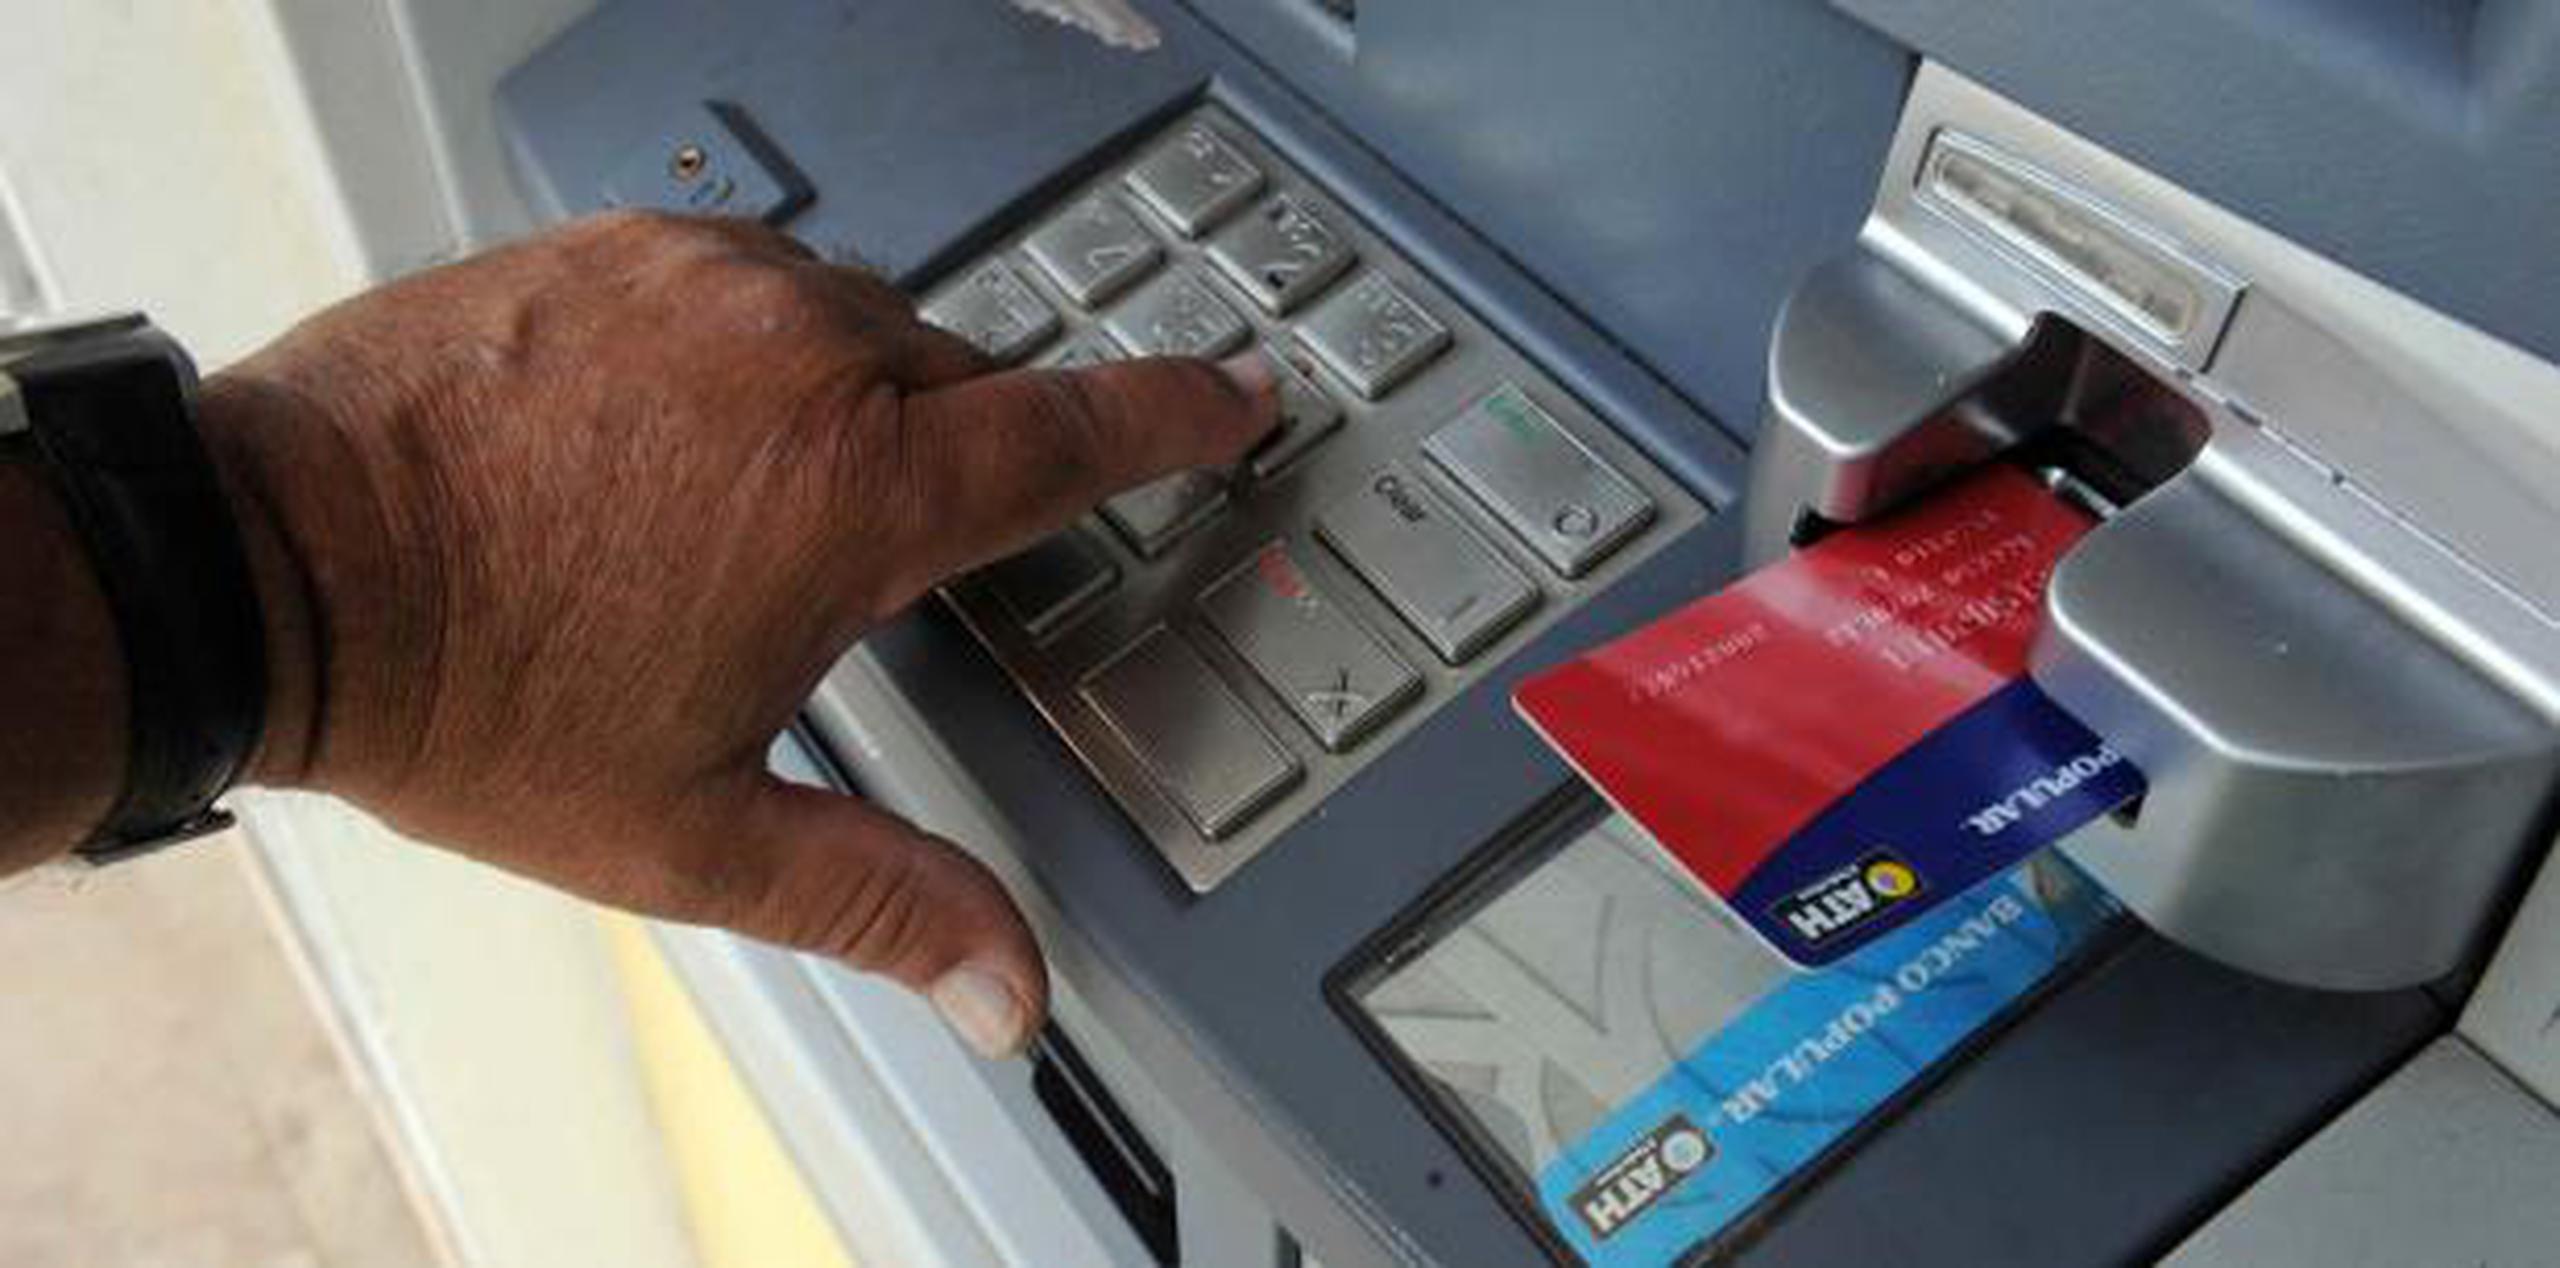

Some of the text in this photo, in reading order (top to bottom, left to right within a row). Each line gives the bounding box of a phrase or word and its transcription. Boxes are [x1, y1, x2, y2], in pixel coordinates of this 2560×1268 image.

[1974, 743, 2121, 837] POPULAR
[1789, 872, 1882, 940] ATH
[1722, 894, 2022, 1124] BANCO POPULAR
[1584, 1152, 1671, 1233] ATH
